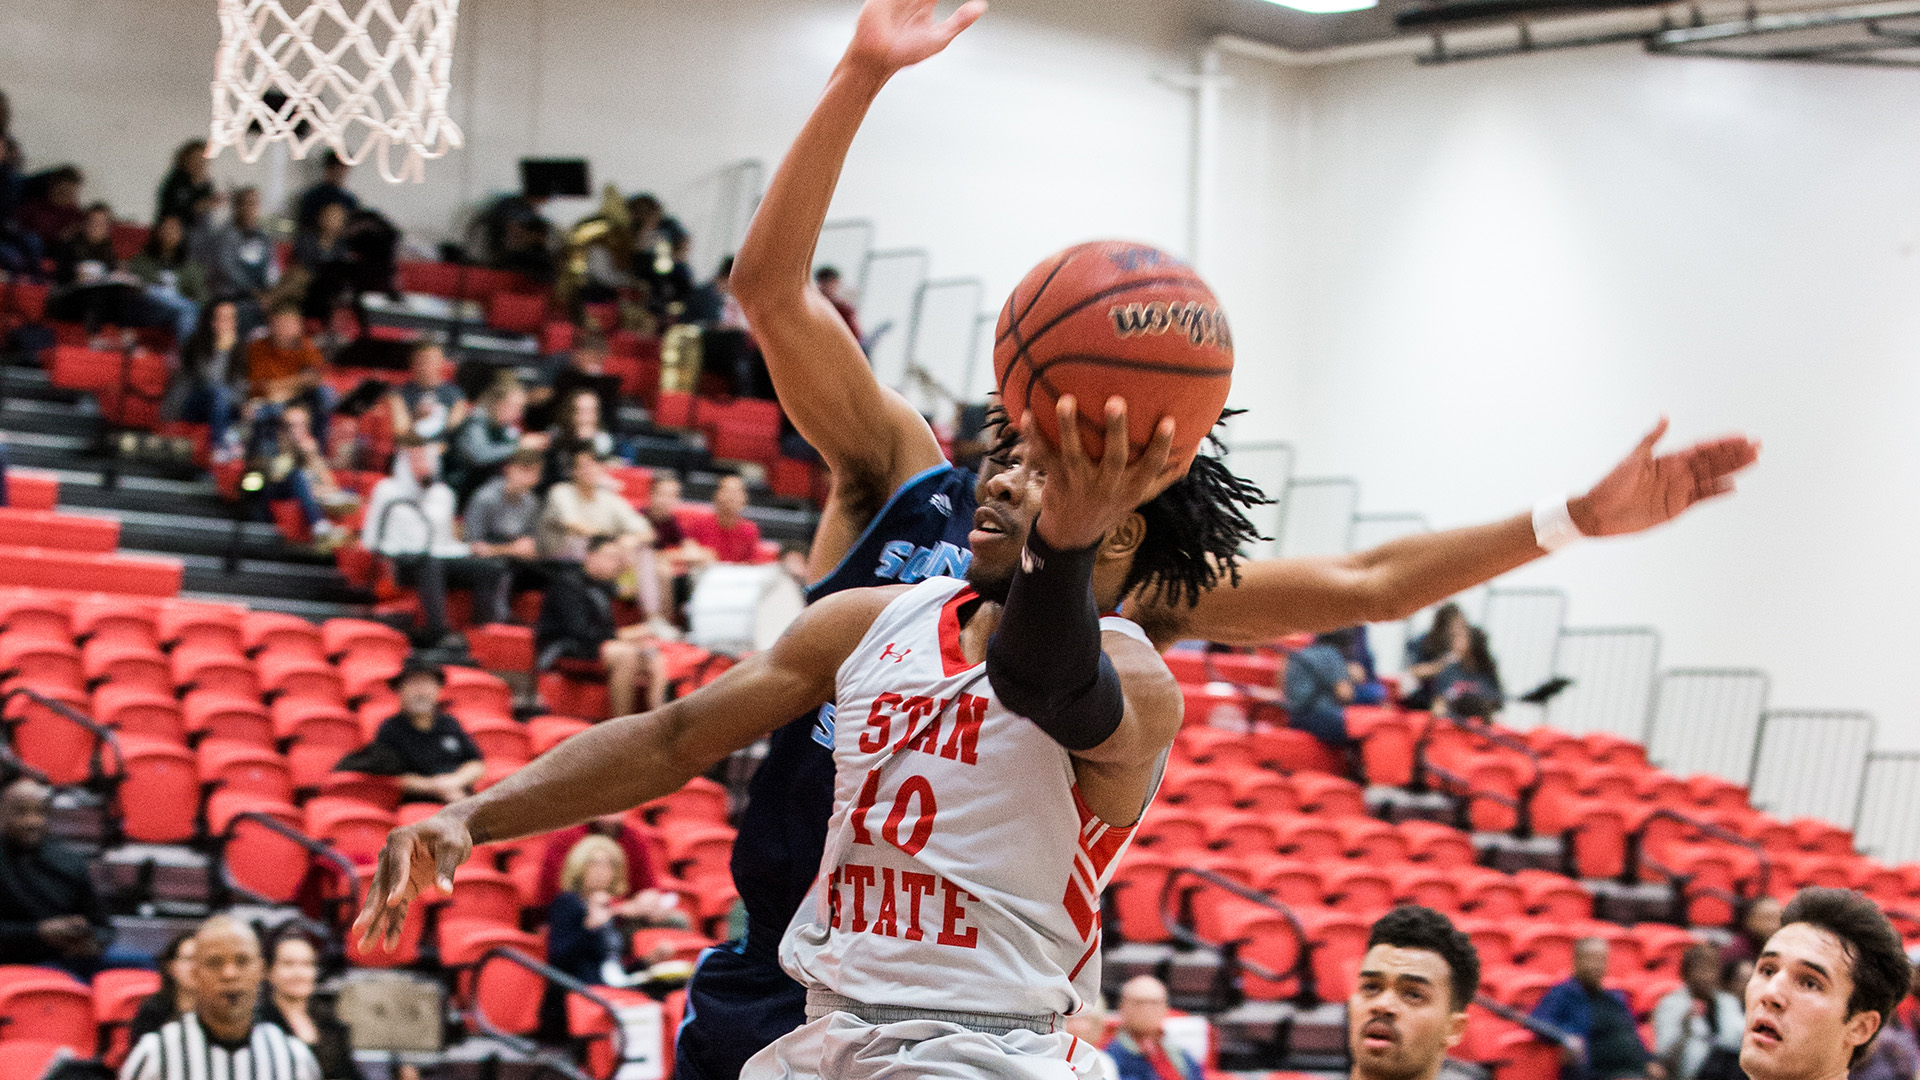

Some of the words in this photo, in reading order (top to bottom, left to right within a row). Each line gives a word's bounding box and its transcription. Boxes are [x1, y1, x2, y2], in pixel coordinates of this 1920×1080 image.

[858, 691, 989, 765] STAN
[850, 766, 938, 857] 10
[828, 863, 980, 949] STATE
